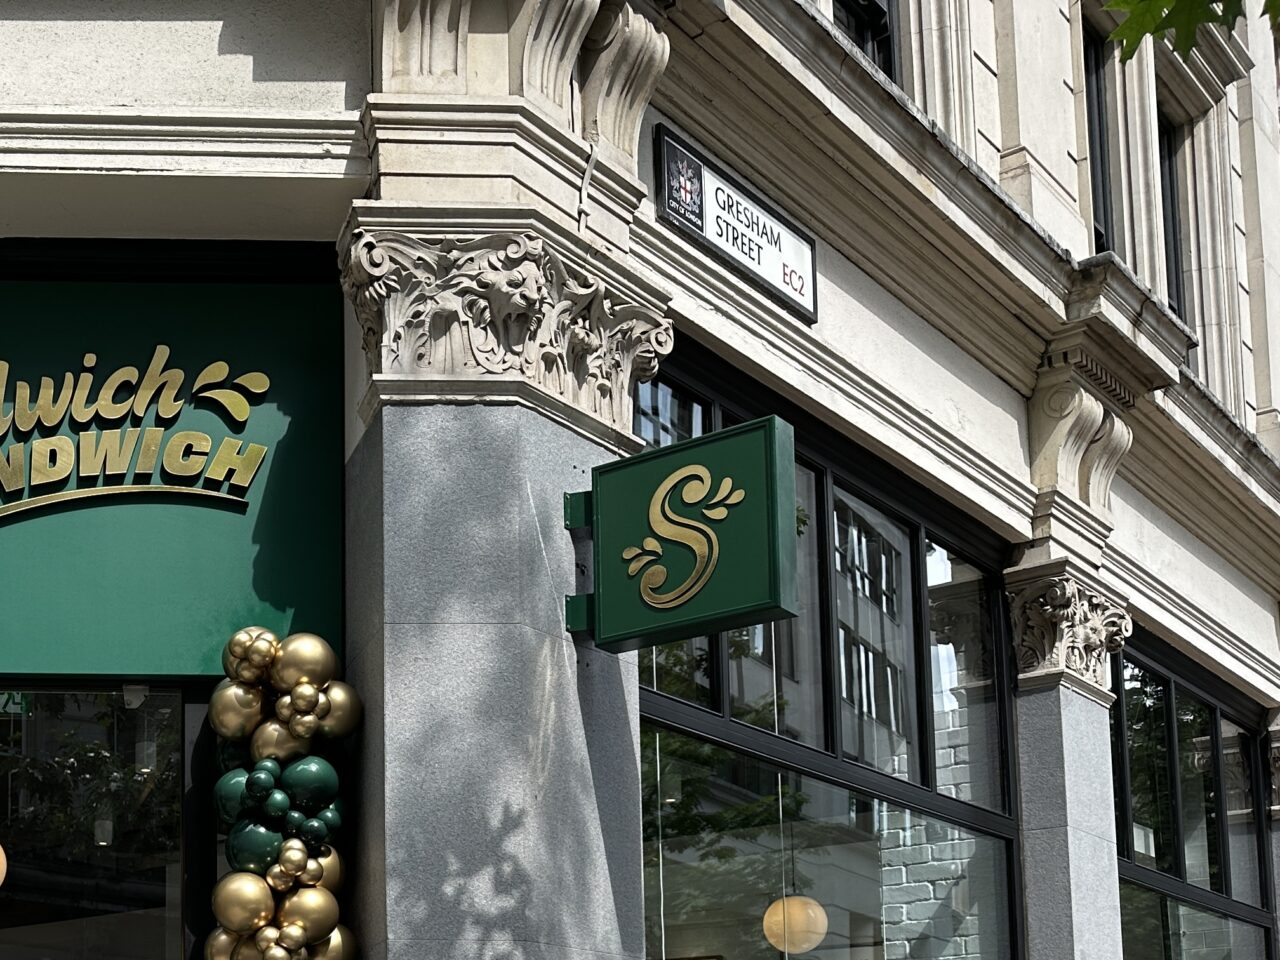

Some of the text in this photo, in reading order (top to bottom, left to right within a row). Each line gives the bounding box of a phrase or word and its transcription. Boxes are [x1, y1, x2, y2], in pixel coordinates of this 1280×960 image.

[669, 199, 679, 210] CITY
[679, 206, 685, 214] OF
[685, 210, 702, 226] LONDON
[715, 187, 782, 252] GRESHAM
[716, 215, 764, 265] STREET
[782, 262, 806, 297] EC2
